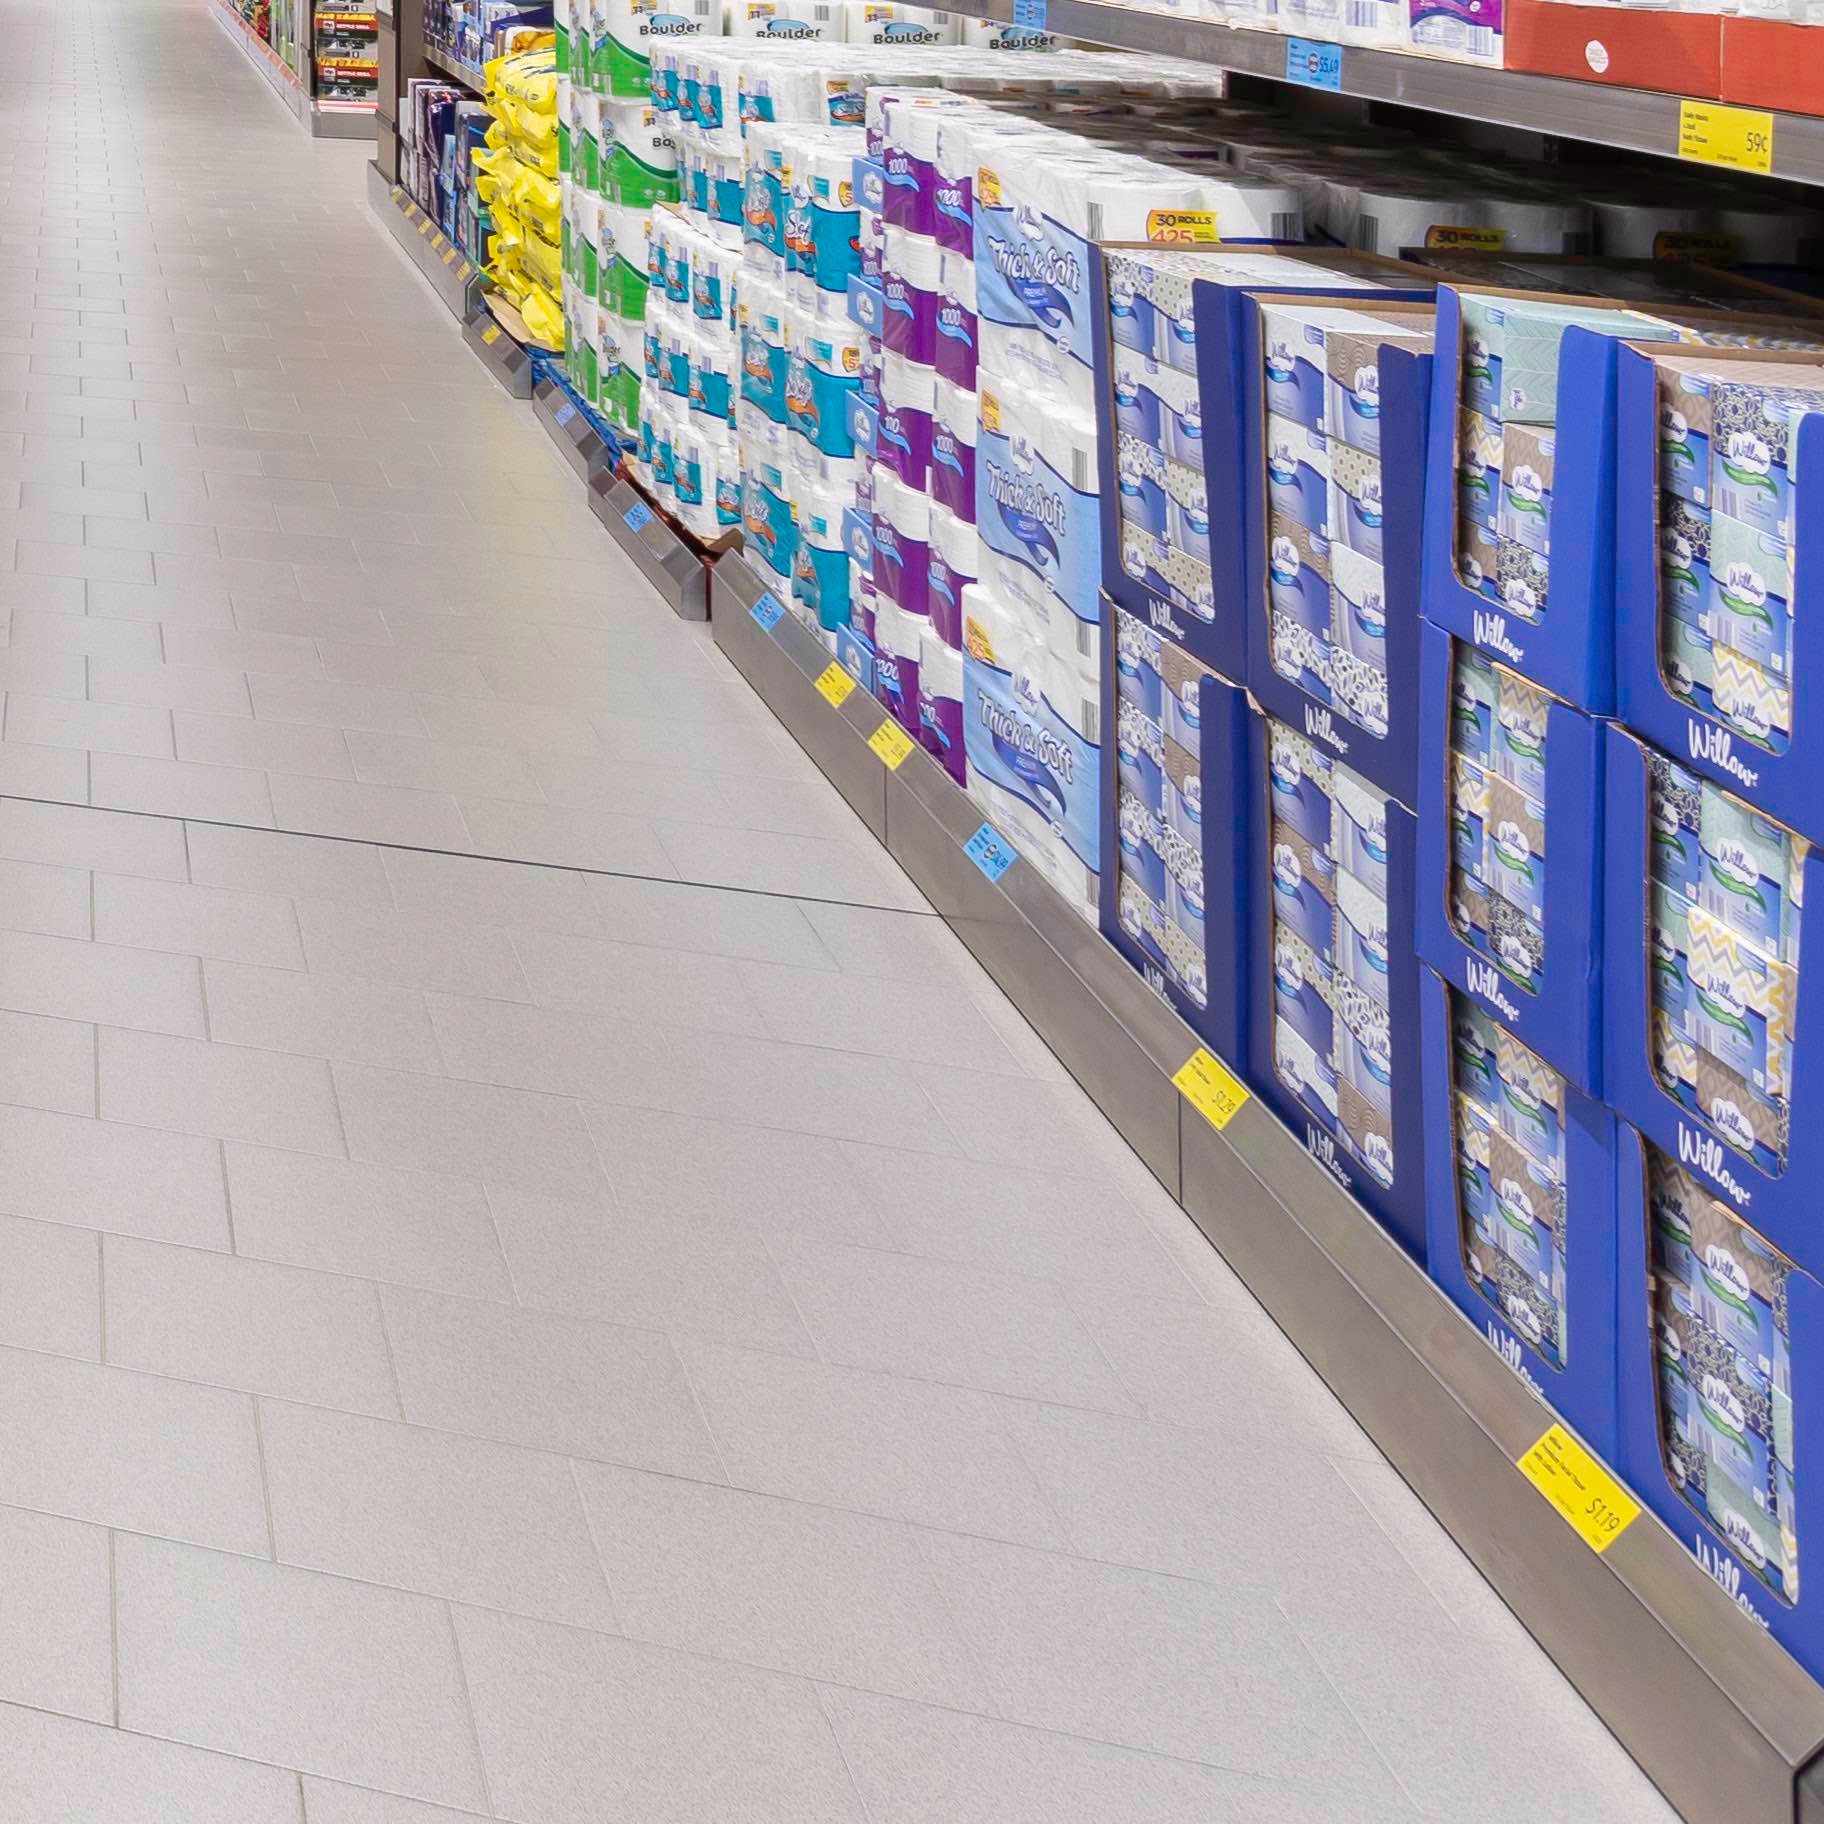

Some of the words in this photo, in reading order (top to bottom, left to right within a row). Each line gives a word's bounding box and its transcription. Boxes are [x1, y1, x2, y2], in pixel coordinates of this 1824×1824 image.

[639, 21, 704, 37] Boulder
[756, 28, 823, 39] Boulder
[873, 29, 942, 45] Boulder
[989, 33, 1056, 50] Boulder
[1152, 229, 1194, 243] 425
[1154, 214, 1178, 227] 30
[1178, 215, 1213, 226] ROLLS
[988, 236, 1032, 279] Thick
[1047, 246, 1081, 294] Soft
[985, 459, 1024, 510] Thick
[1035, 482, 1067, 537] Soft
[1473, 609, 1525, 664] Willow
[976, 688, 1022, 747] Thick
[1038, 727, 1074, 785] Soft
[1304, 702, 1349, 754] Willow
[1687, 718, 1758, 788] Willow
[1465, 956, 1519, 1023] Willow
[1677, 1120, 1750, 1207] Willow
[1584, 1497, 1621, 1534] $1.19
